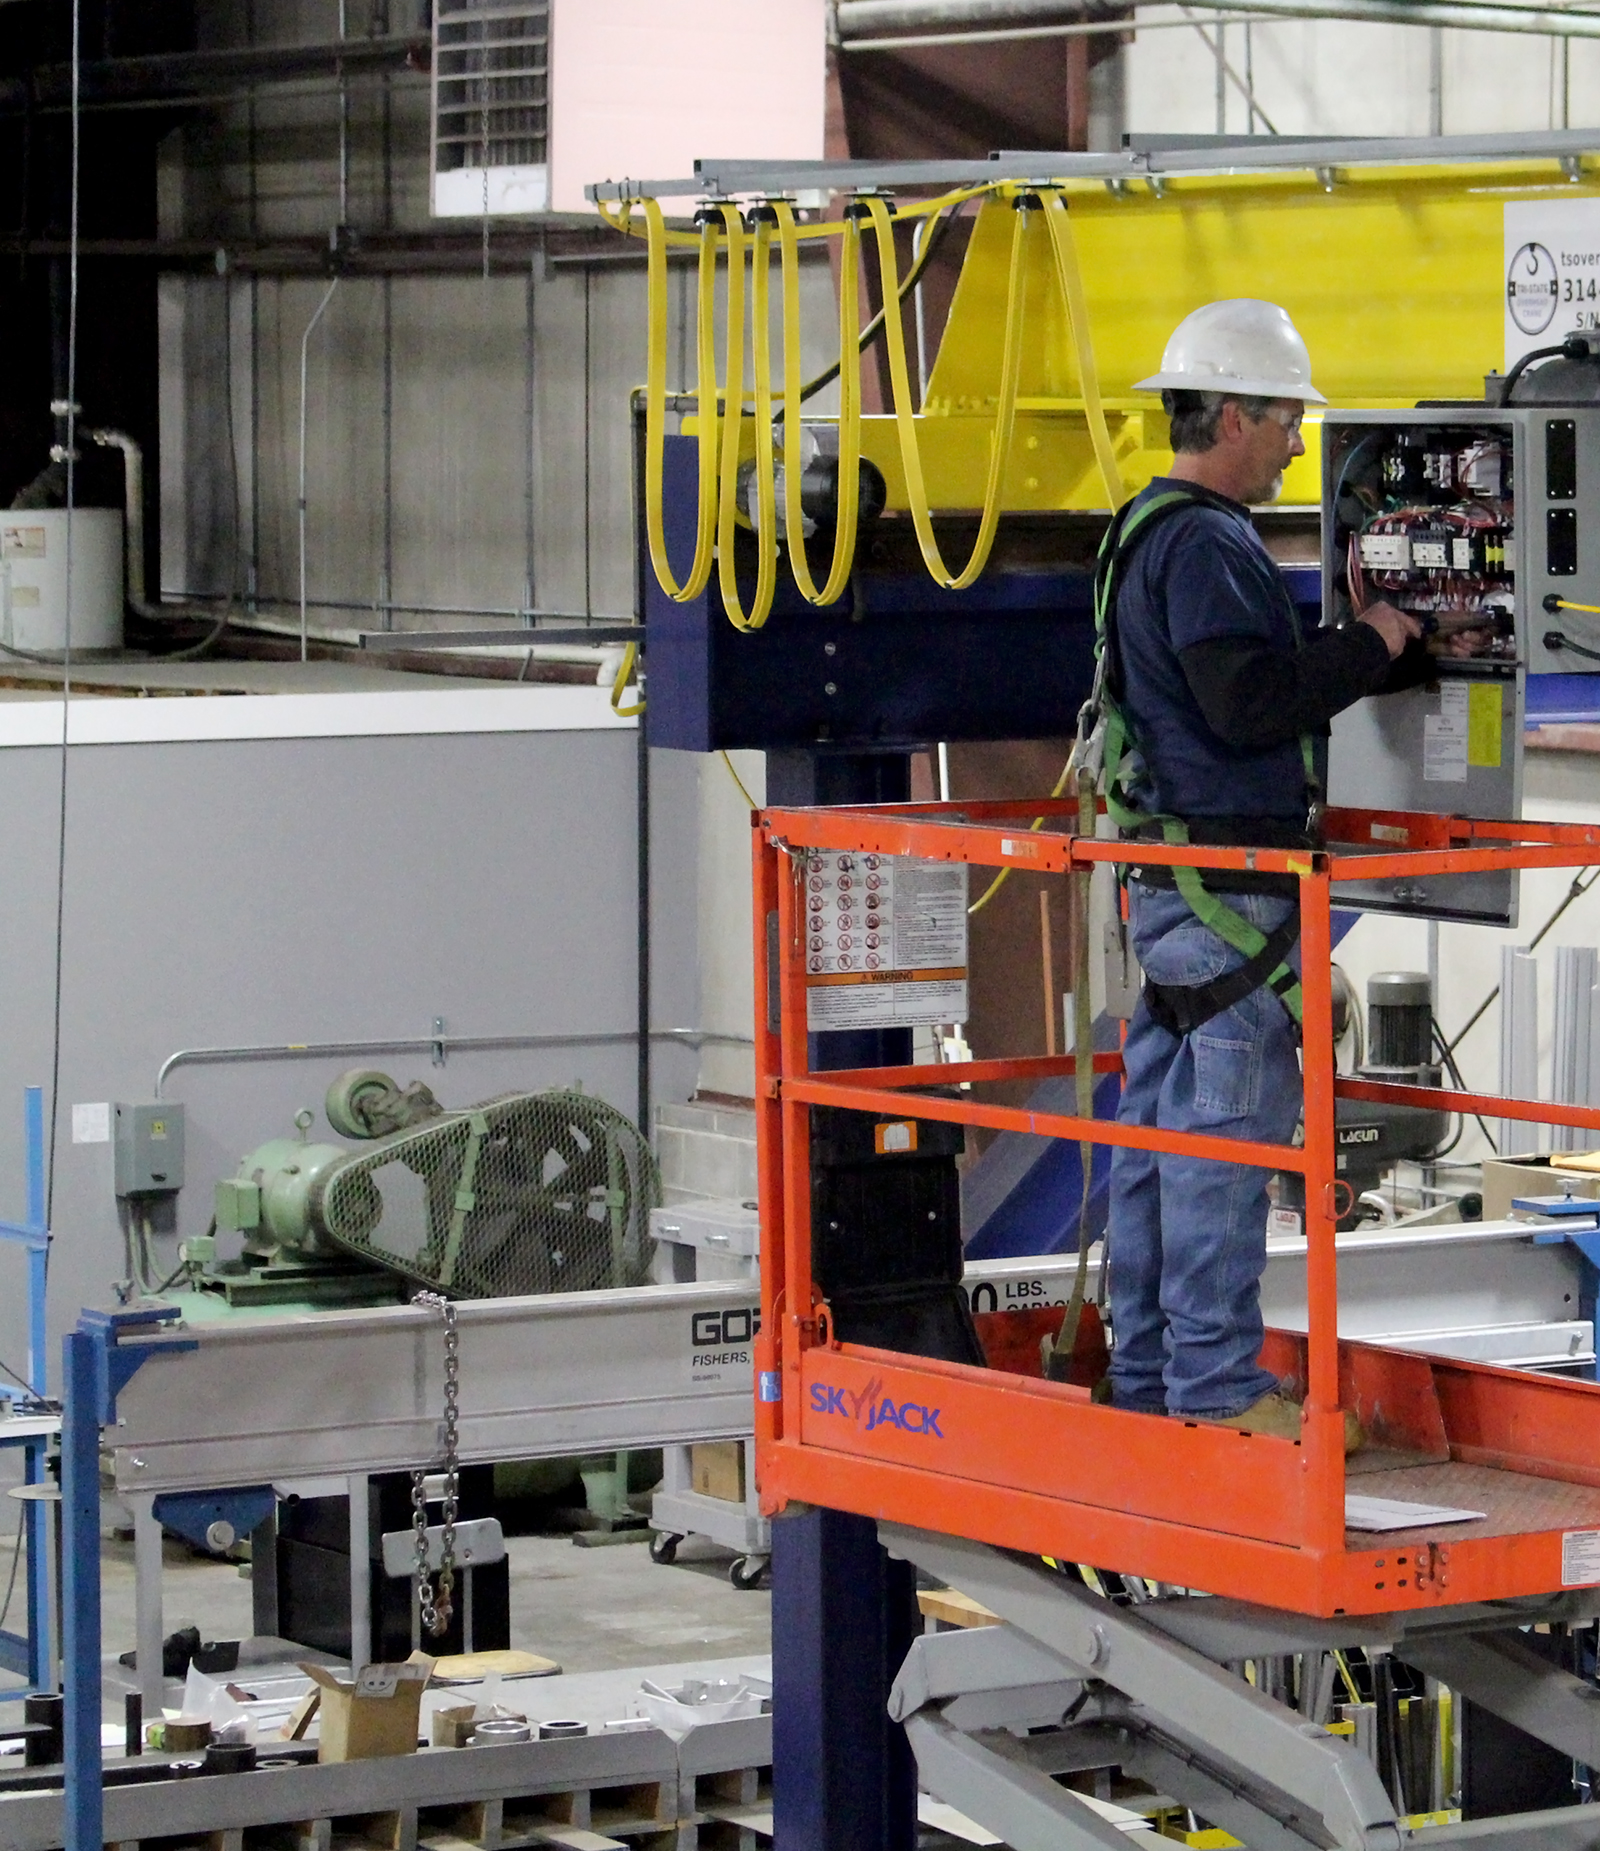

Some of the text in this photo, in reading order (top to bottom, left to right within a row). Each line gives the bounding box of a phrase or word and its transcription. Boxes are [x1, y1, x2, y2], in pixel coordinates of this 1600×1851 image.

[871, 971, 914, 982] WARNING
[1005, 1280, 1048, 1299] LBS.
[692, 1351, 750, 1367] FISHERS,
[810, 1375, 945, 1438] SKYJACK
